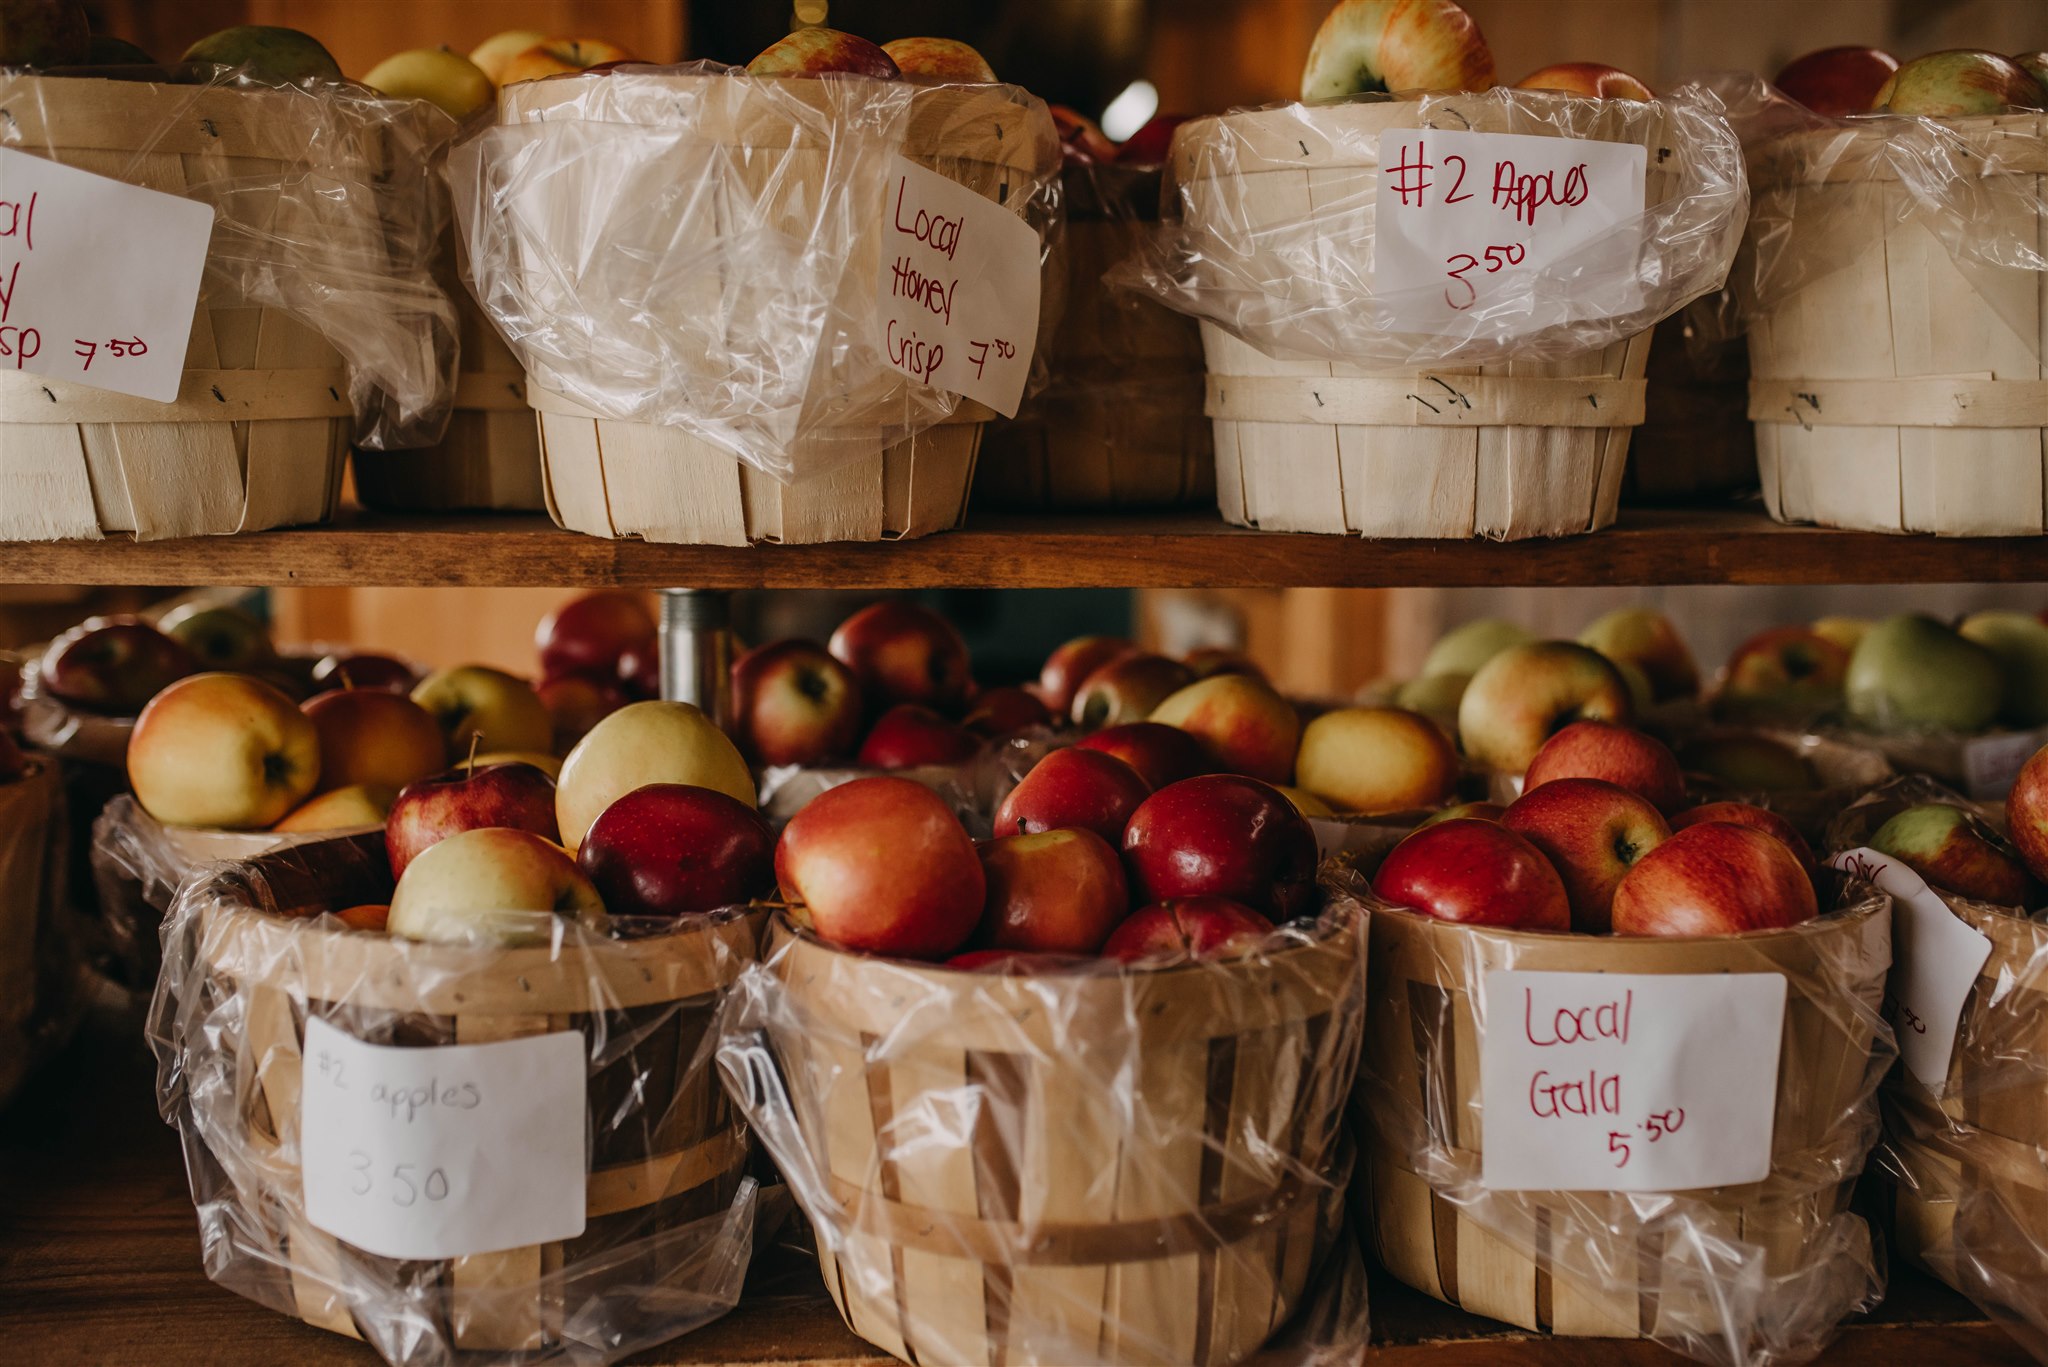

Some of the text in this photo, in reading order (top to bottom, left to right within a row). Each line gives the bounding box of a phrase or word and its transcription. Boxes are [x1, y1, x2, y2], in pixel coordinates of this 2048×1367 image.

[895, 176, 963, 261] Local
[1492, 161, 1589, 226] Apples
[892, 256, 959, 326] Honey
[75, 336, 148, 371] 7.50
[887, 319, 1015, 384] Crisp 7.50
[1525, 987, 1632, 1046] Local
[370, 1077, 481, 1124] apples
[1530, 1069, 1620, 1118] Gala
